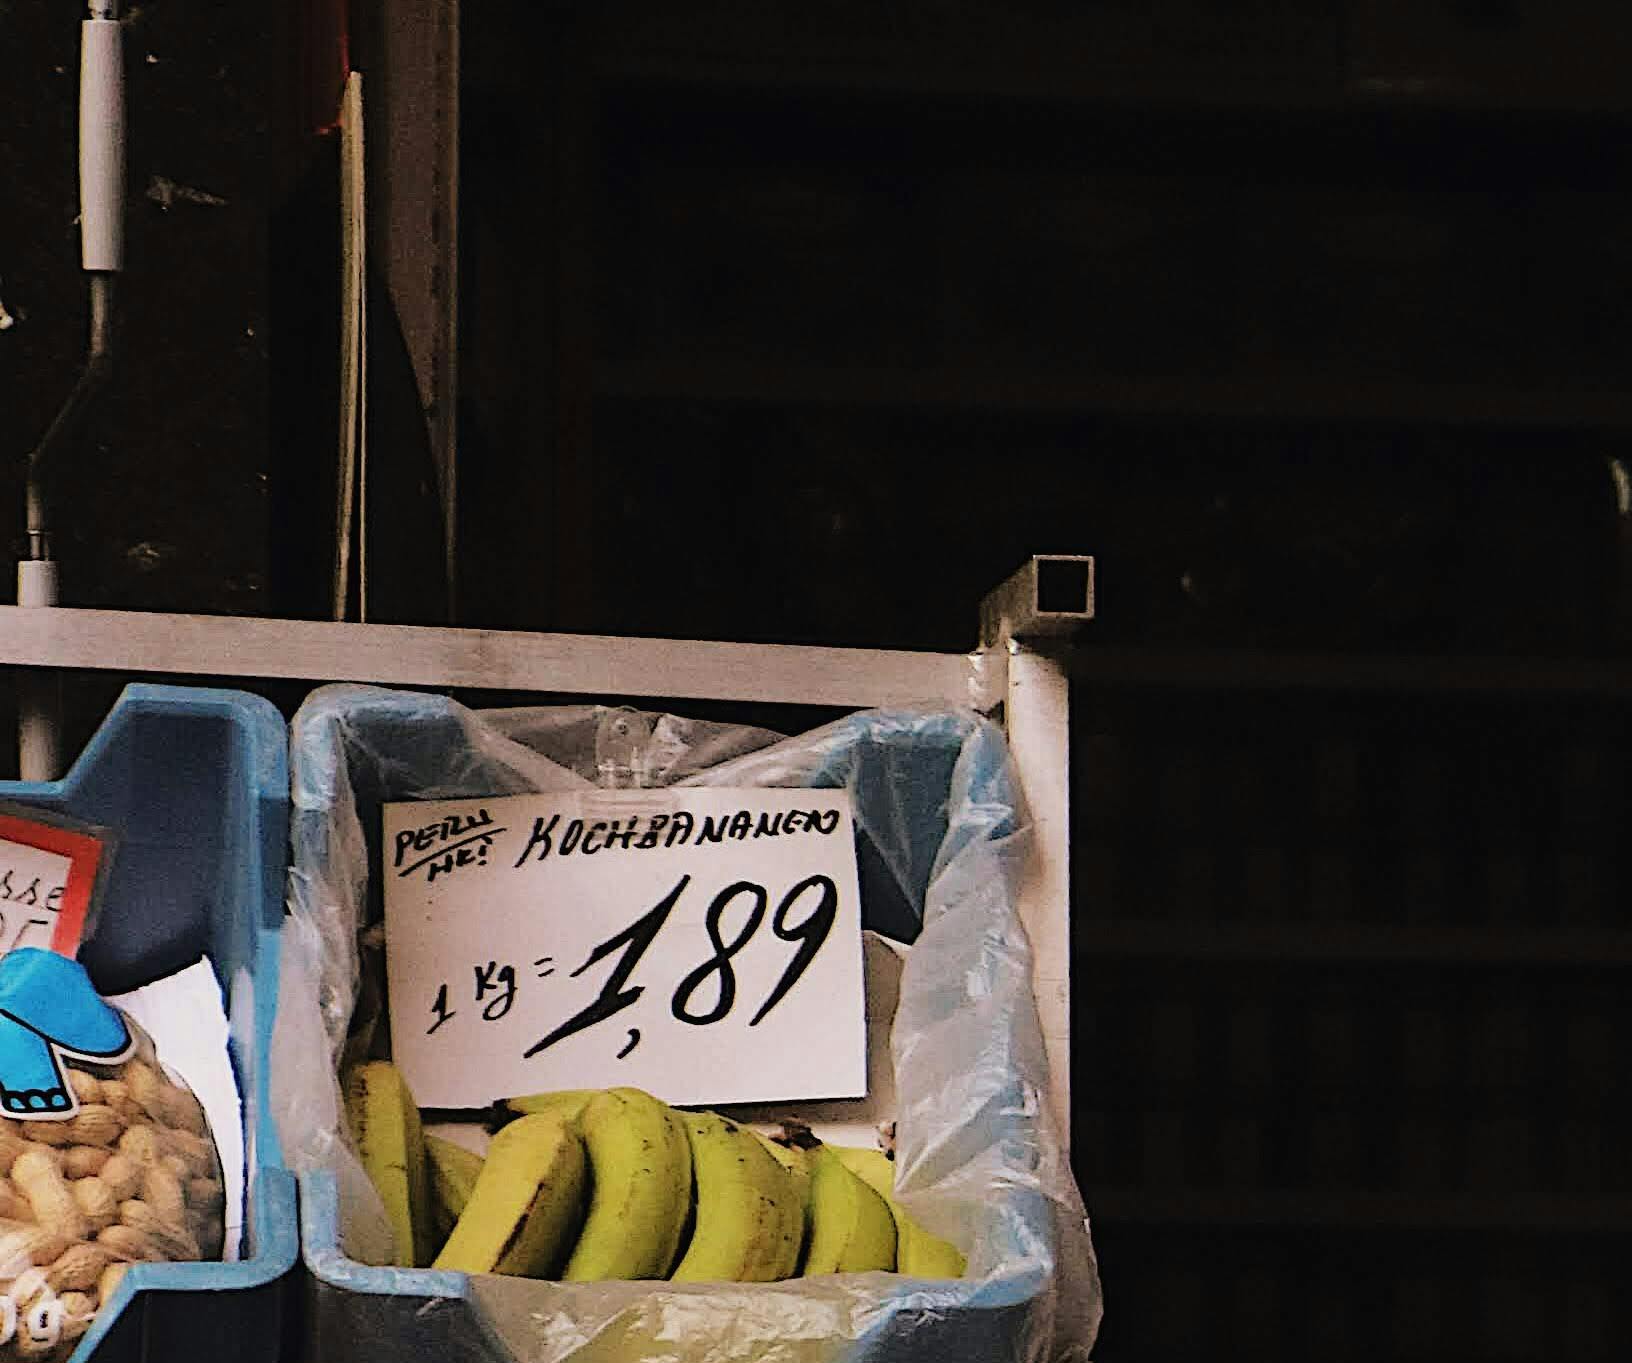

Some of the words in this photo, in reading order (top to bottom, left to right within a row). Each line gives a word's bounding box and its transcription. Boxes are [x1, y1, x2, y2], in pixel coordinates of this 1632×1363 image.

[514, 808, 841, 868] KOCHBANANEN
[426, 984, 455, 1035] 1
[522, 873, 839, 1060] 1,89
